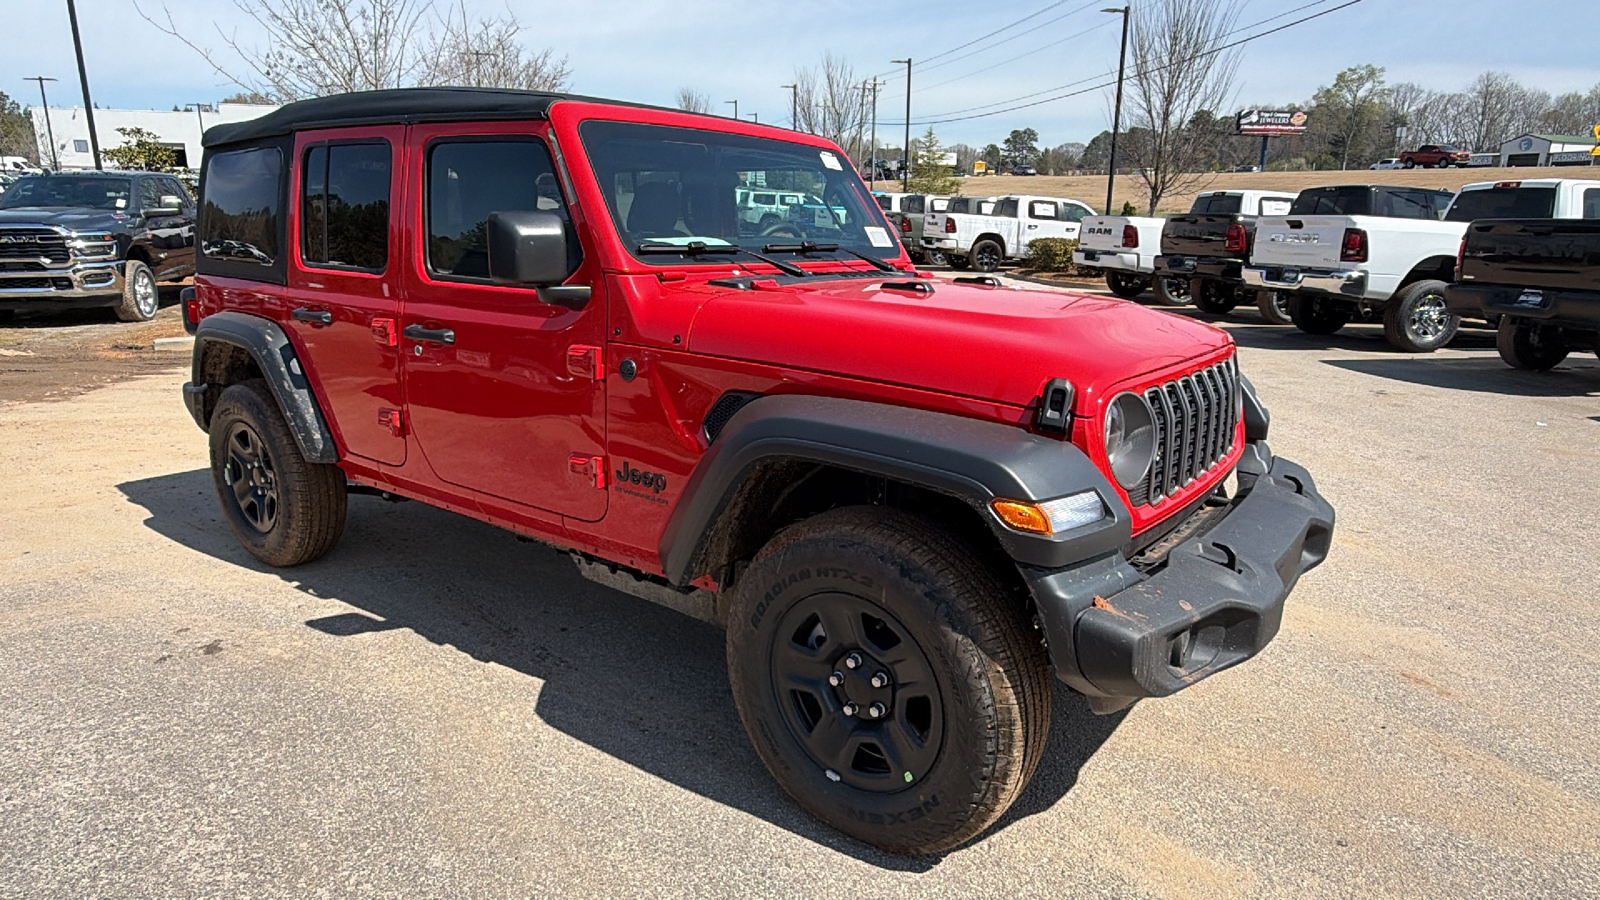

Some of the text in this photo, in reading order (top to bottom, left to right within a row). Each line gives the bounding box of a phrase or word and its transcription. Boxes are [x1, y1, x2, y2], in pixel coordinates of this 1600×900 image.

[1521, 140, 1529, 150] F
[1088, 227, 1112, 236] RAM
[1270, 232, 1320, 244] RAM
[615, 461, 667, 494] Jeep
[750, 567, 811, 630] ROADIAN
[845, 793, 941, 826] NEXEN
